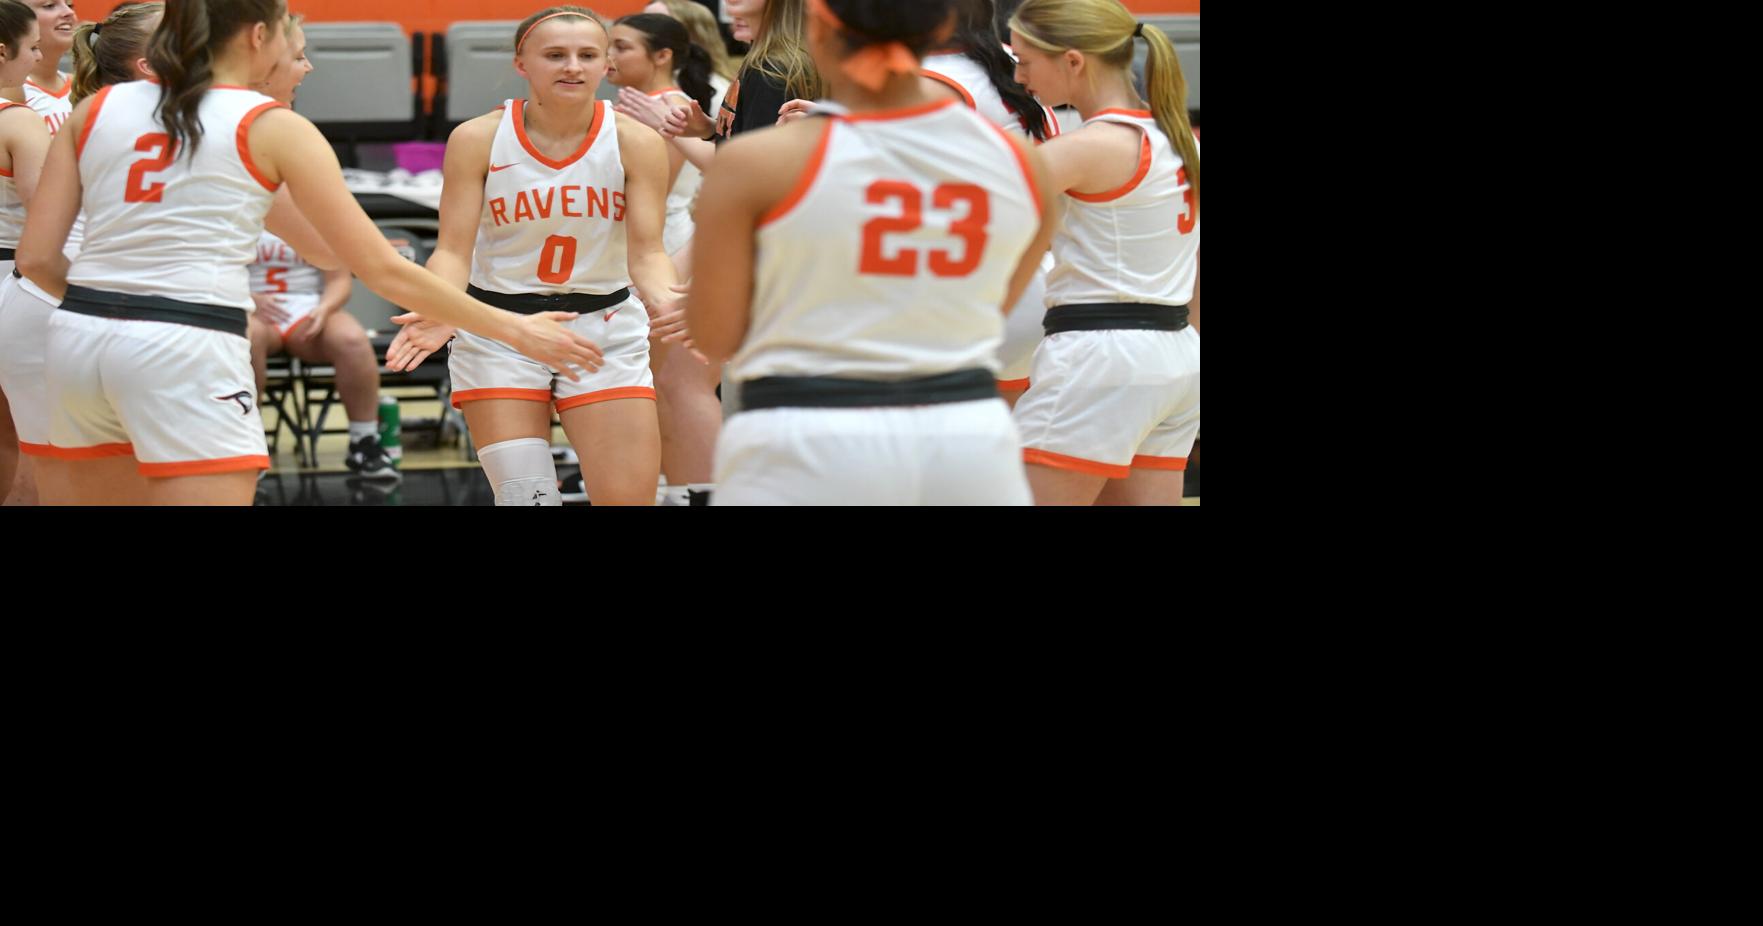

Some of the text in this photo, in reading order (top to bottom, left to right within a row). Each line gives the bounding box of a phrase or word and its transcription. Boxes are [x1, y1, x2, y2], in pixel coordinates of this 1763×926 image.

[124, 131, 182, 203] 2
[489, 185, 625, 226] RAVENS
[858, 178, 990, 278] 23
[265, 267, 288, 293] 5
[536, 234, 577, 284] 0
